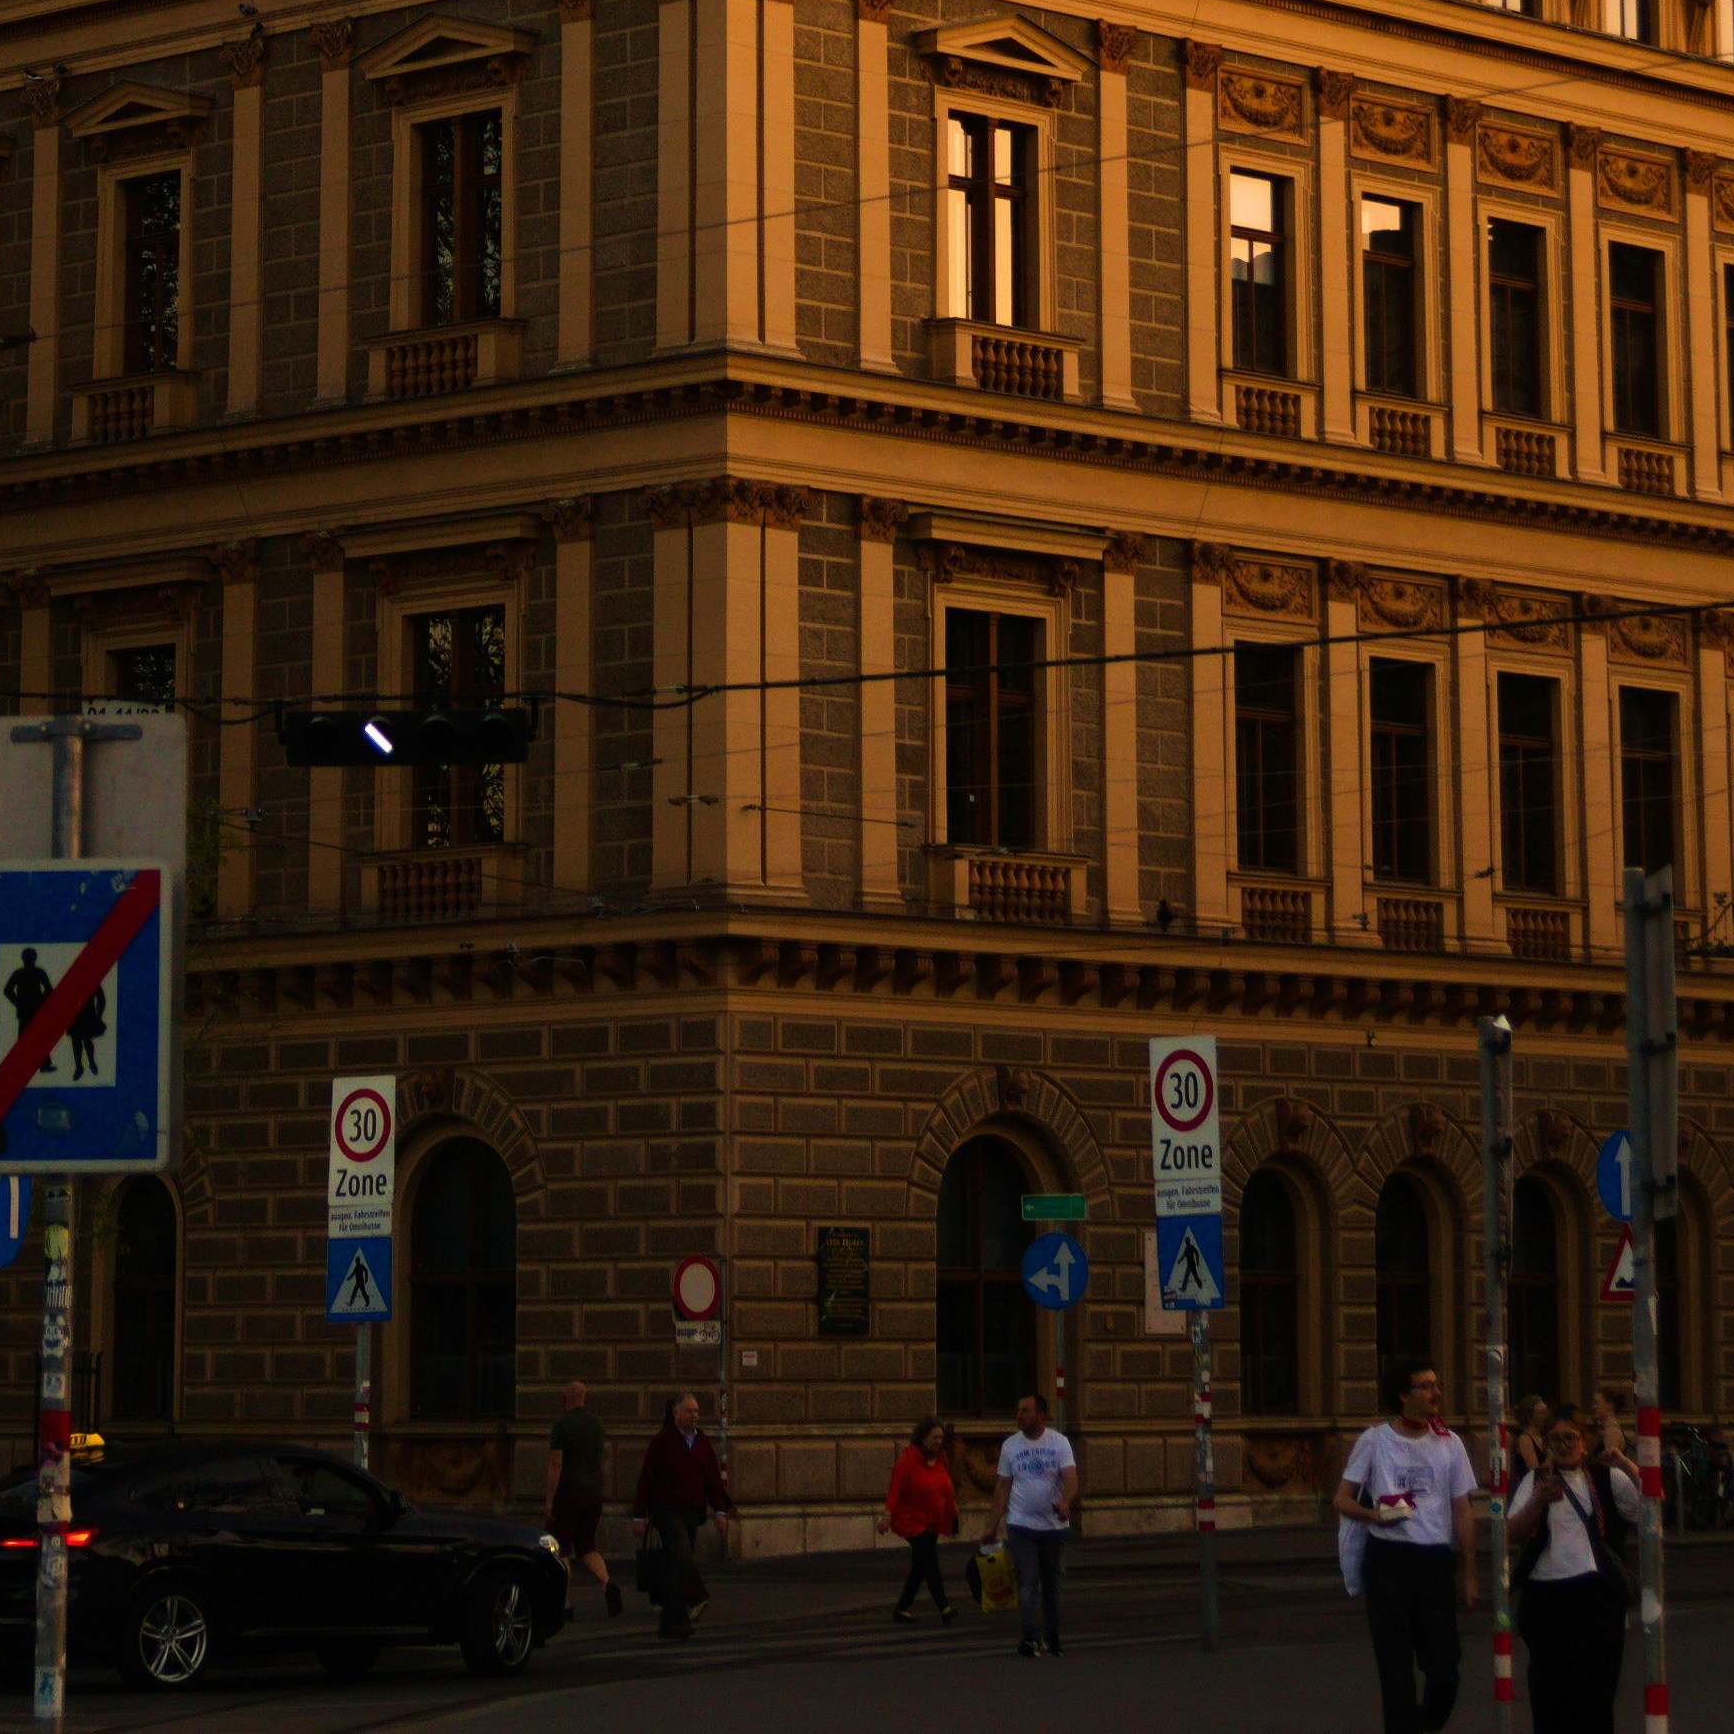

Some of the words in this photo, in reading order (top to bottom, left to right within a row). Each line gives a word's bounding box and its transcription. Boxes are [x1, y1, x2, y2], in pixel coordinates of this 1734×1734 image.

[1170, 1071, 1198, 1109] 30
[349, 1108, 376, 1142] 30
[1160, 1138, 1213, 1171] Zone
[335, 1169, 388, 1197] Zone
